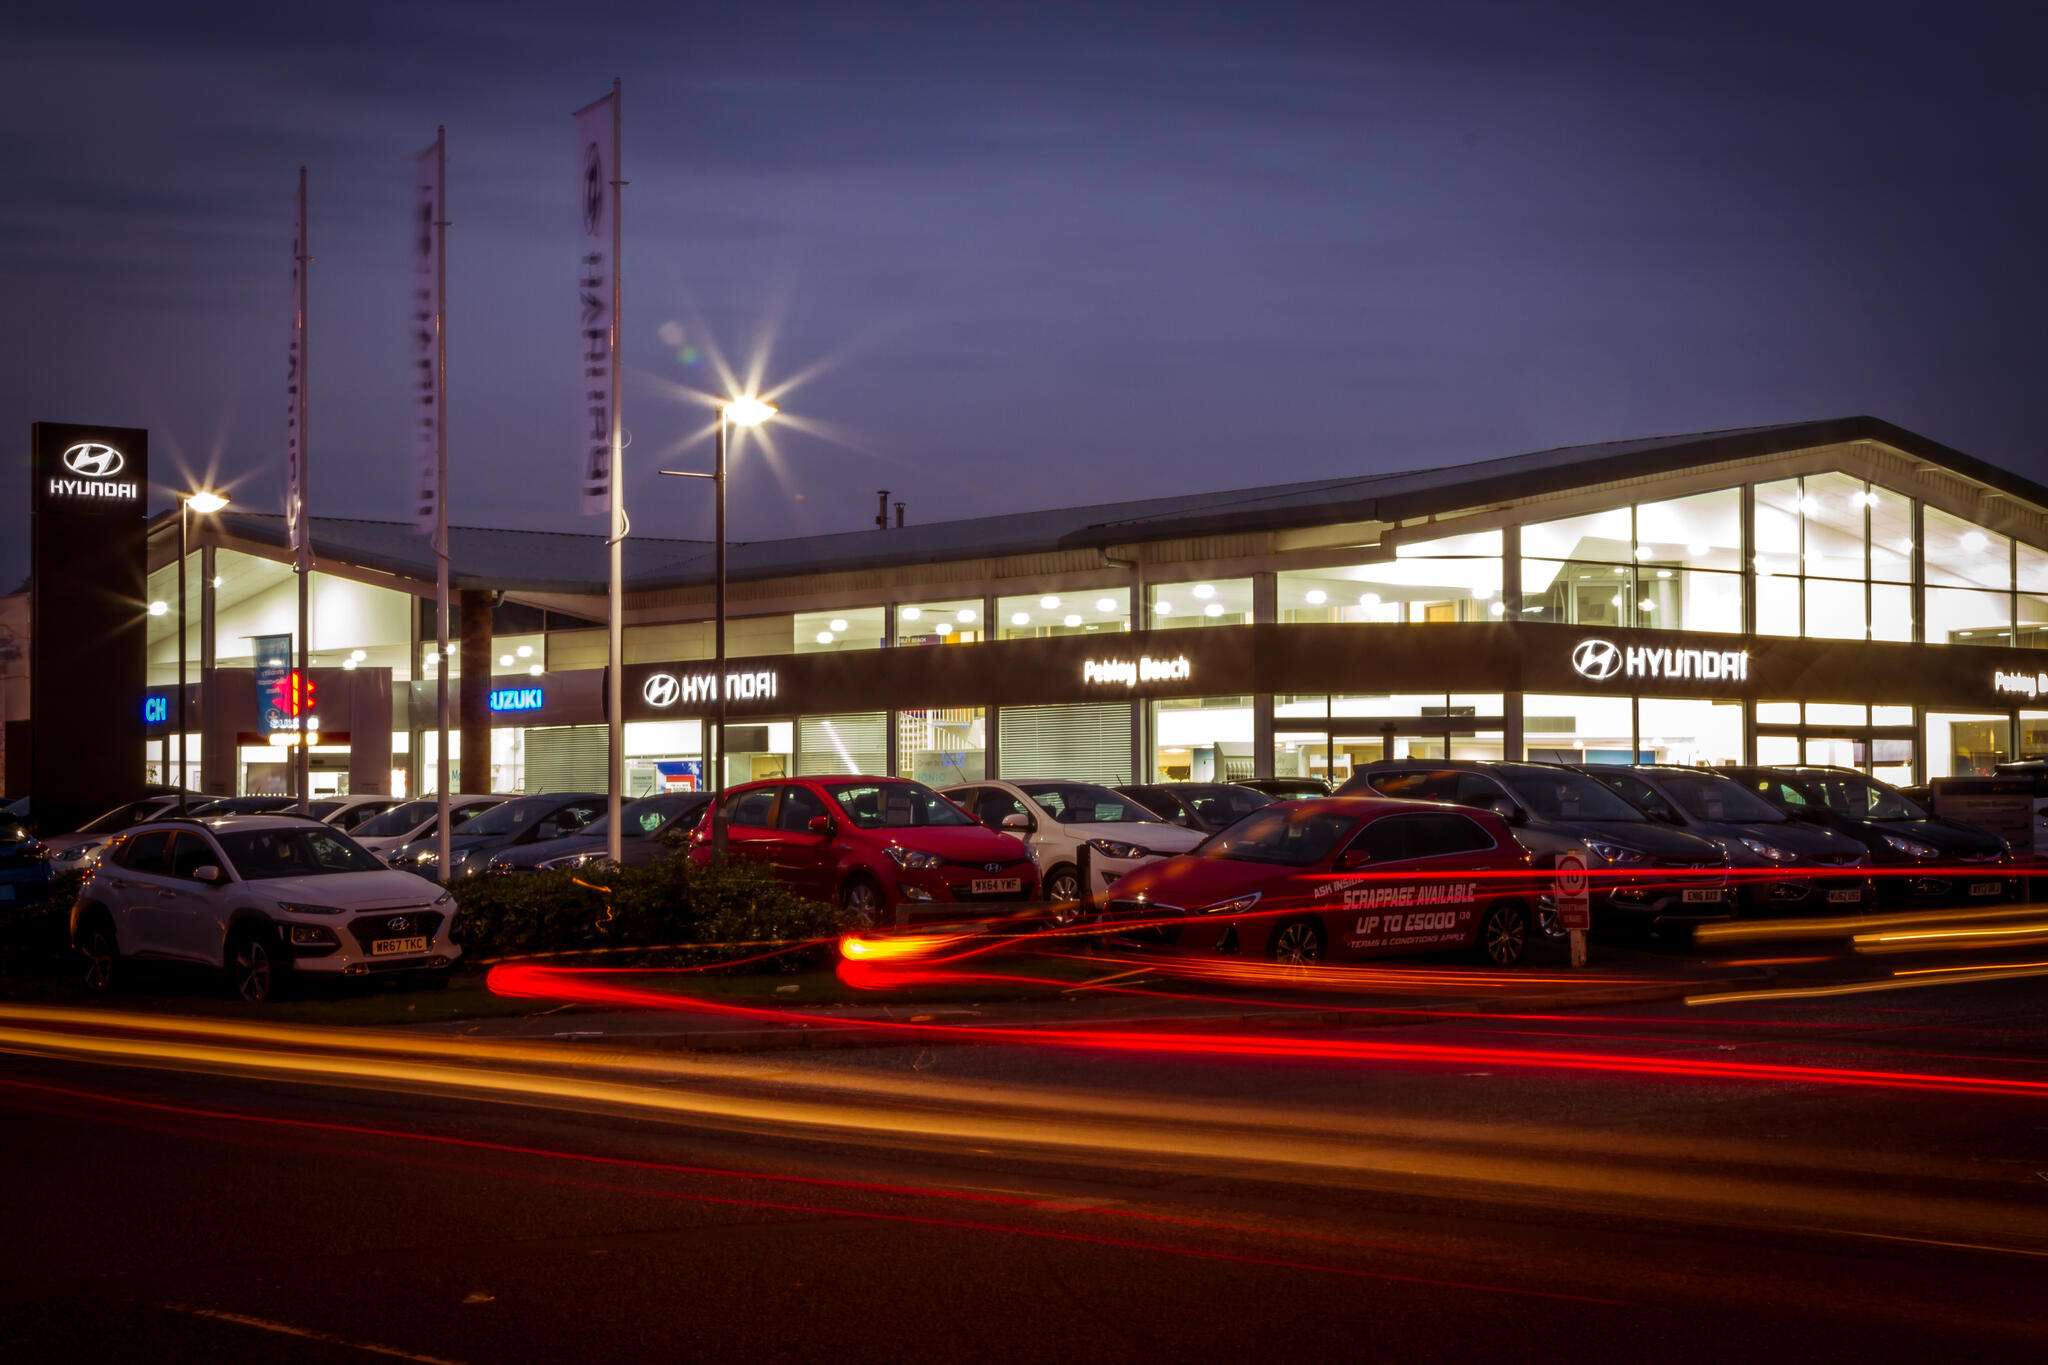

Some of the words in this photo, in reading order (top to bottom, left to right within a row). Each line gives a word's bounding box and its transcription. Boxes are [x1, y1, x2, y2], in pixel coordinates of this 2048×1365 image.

[50, 479, 137, 499] HYUNDAI
[1626, 646, 1749, 681] HYUNDAI
[490, 689, 542, 711] UZUKI
[1314, 883, 1333, 899] ASK
[1342, 886, 1416, 910] SCRAPPAGE
[1416, 883, 1477, 906] AVAILABLE
[1356, 915, 1380, 934] UP
[1383, 914, 1403, 932] TO
[376, 940, 402, 953] WR67
[405, 937, 423, 950] TKC
